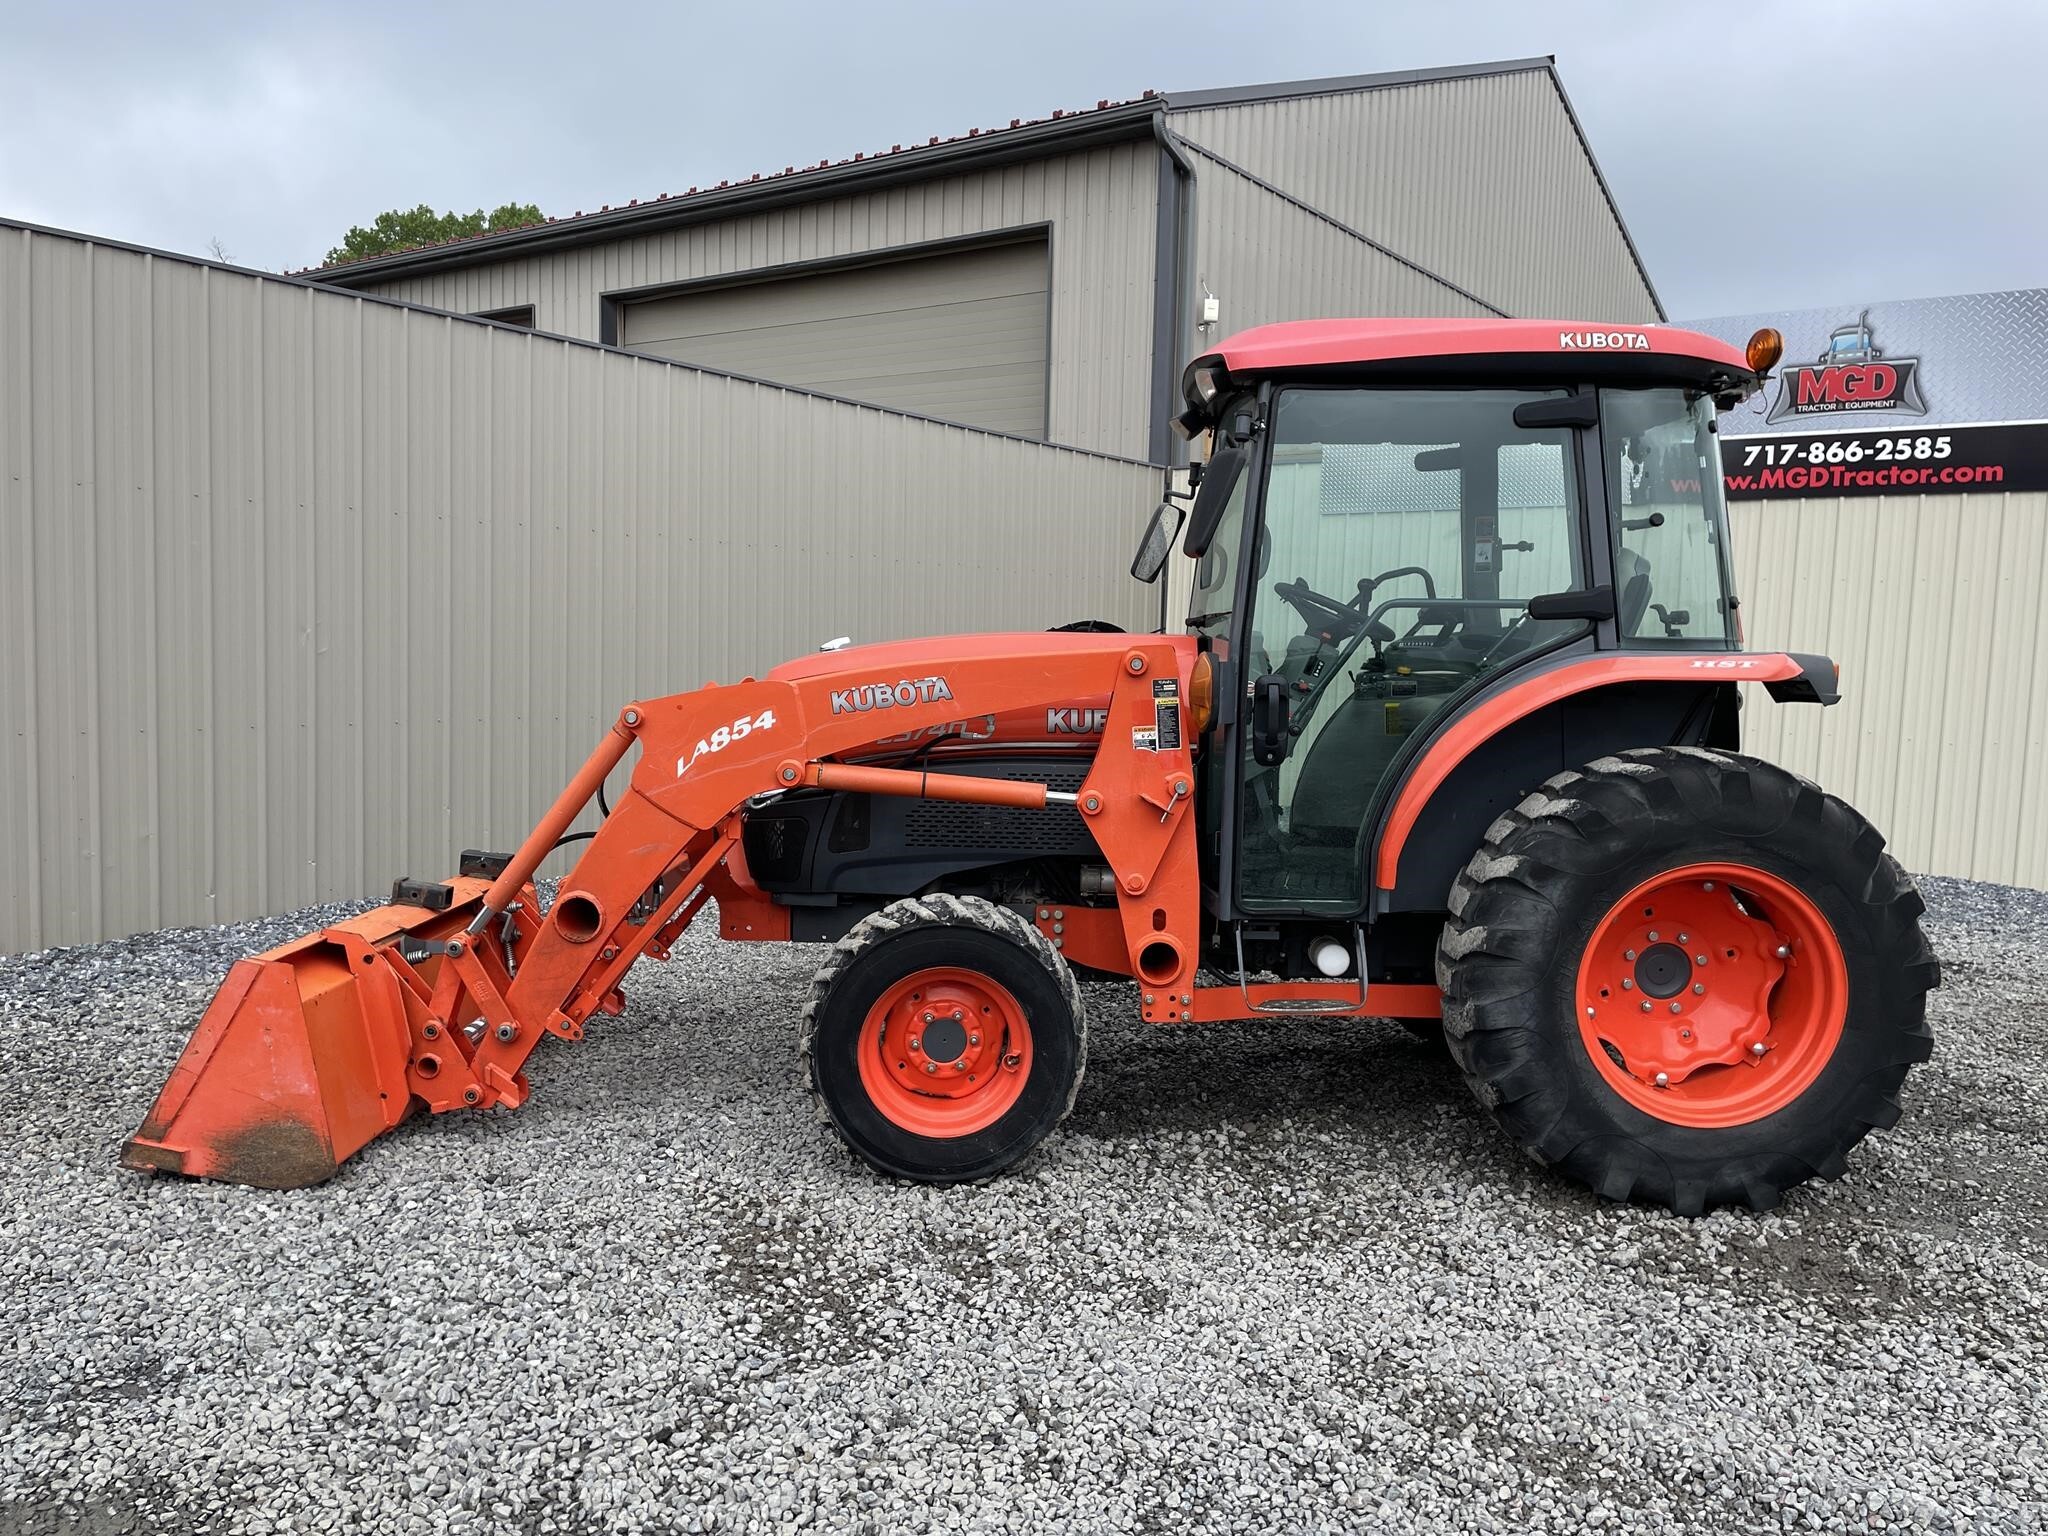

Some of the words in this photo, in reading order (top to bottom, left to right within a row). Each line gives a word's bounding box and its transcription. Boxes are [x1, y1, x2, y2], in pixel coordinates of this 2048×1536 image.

[1559, 331, 1650, 351] KUBOTA
[1797, 364, 1898, 405] MGD
[1797, 403, 1837, 413] TRACTOR
[1845, 399, 1896, 410] EQUIPMENT
[1743, 436, 1952, 467] 717-866-2585
[1689, 660, 1759, 669] HST
[830, 676, 954, 715] KUBOTA
[676, 709, 777, 778] LA854
